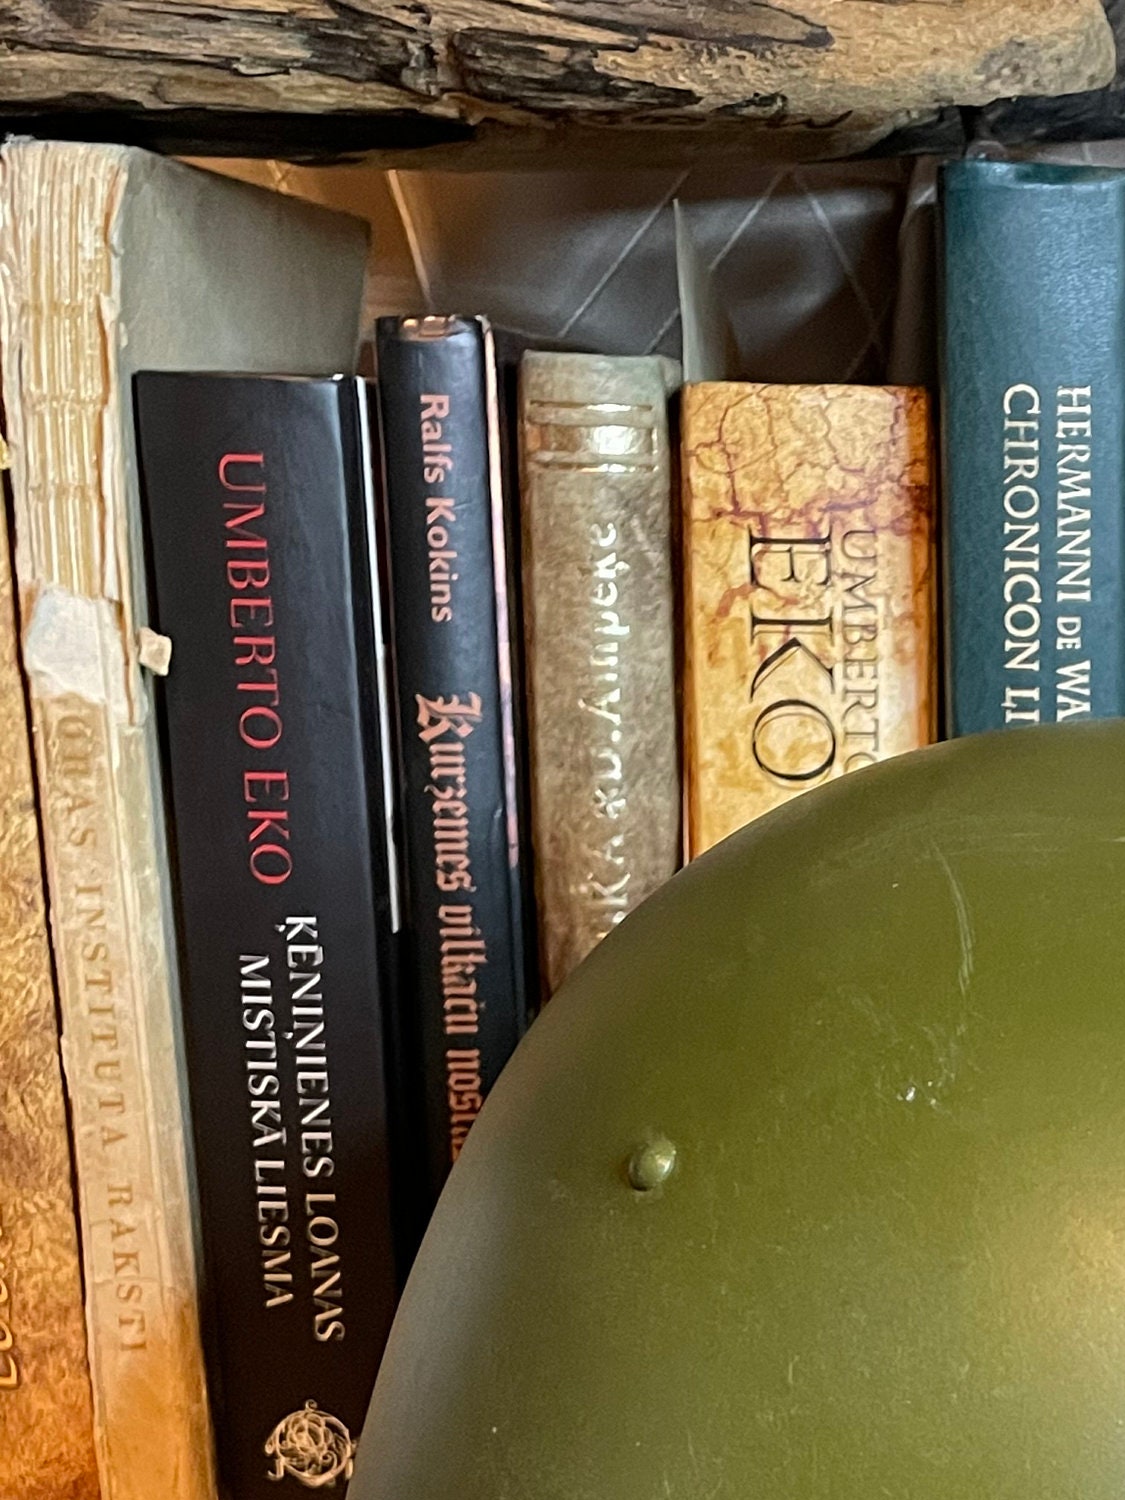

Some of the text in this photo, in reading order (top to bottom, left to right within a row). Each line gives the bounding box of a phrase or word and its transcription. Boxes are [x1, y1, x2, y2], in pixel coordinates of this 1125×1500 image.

[419, 394, 456, 625] Ralfs Kokins
[1003, 382, 1042, 671] CHRONICON
[1055, 384, 1092, 603] HERMANNI
[217, 452, 294, 886] UMBERTO EKO
[748, 531, 837, 783] EKO
[1055, 616, 1083, 650] DE
[414, 692, 484, 893] Kurzemes
[73, 885, 129, 1149] INSTITUTA
[106, 1183, 148, 1354] RAKSTI
[239, 953, 295, 1309] MISTISKĀ LIESMA
[275, 914, 347, 1343] ĶĒNIŅIENES LOANAS
